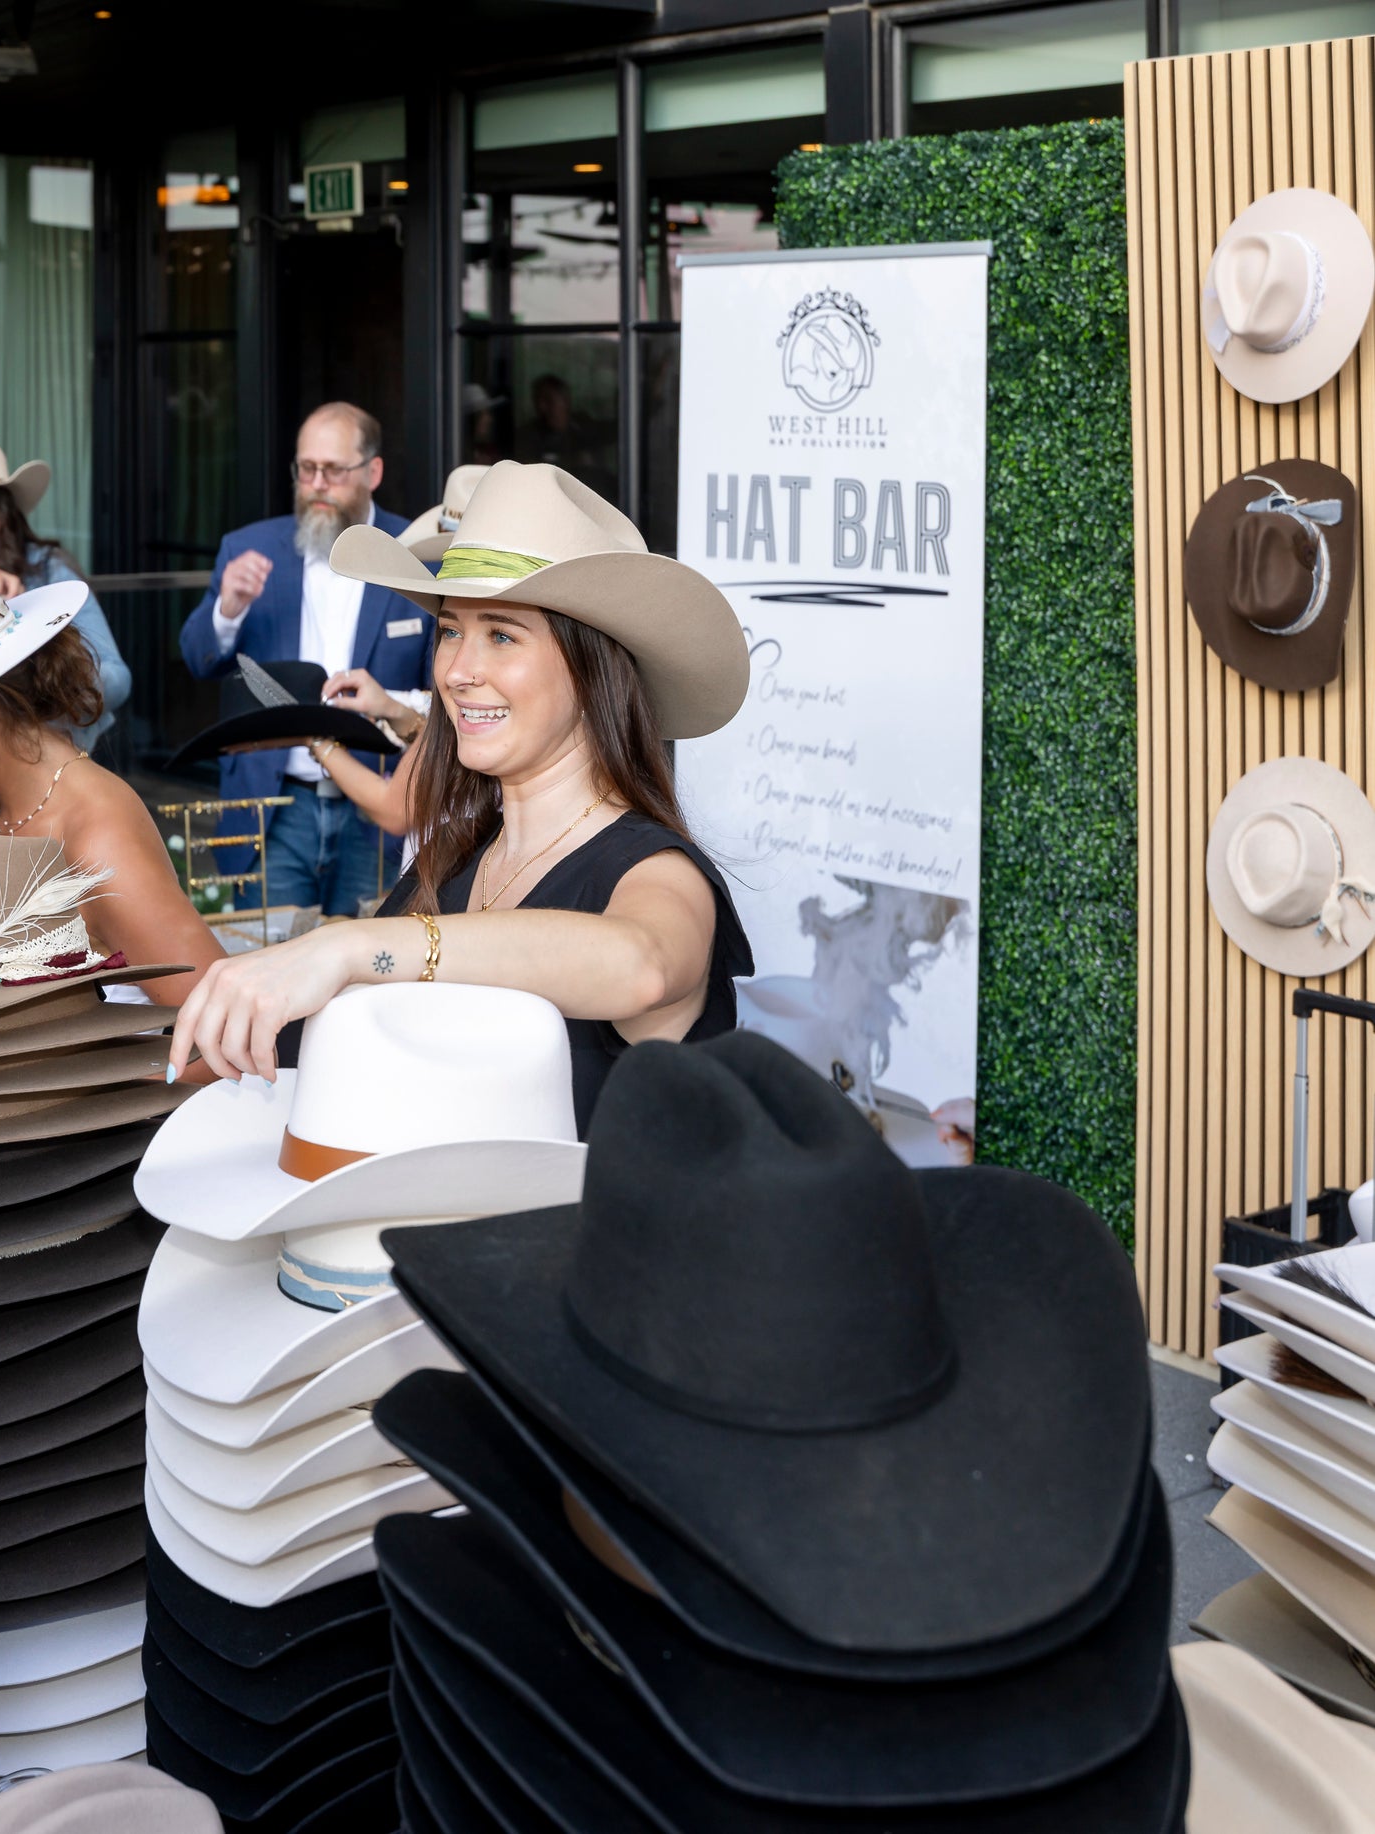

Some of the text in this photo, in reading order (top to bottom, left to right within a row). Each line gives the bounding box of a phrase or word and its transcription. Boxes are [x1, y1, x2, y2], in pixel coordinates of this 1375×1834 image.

[314, 172, 349, 211] EXIT
[768, 415, 888, 436] WEST HILL
[769, 438, 886, 449] HAT COLLECTION
[706, 474, 951, 576] HAT BAR
[798, 690, 820, 709] your
[824, 684, 846, 706] hat
[797, 745, 819, 763] your
[792, 794, 814, 813] your
[819, 789, 846, 815] add
[865, 797, 891, 824] and
[824, 841, 863, 862] further
[868, 851, 894, 870] with
